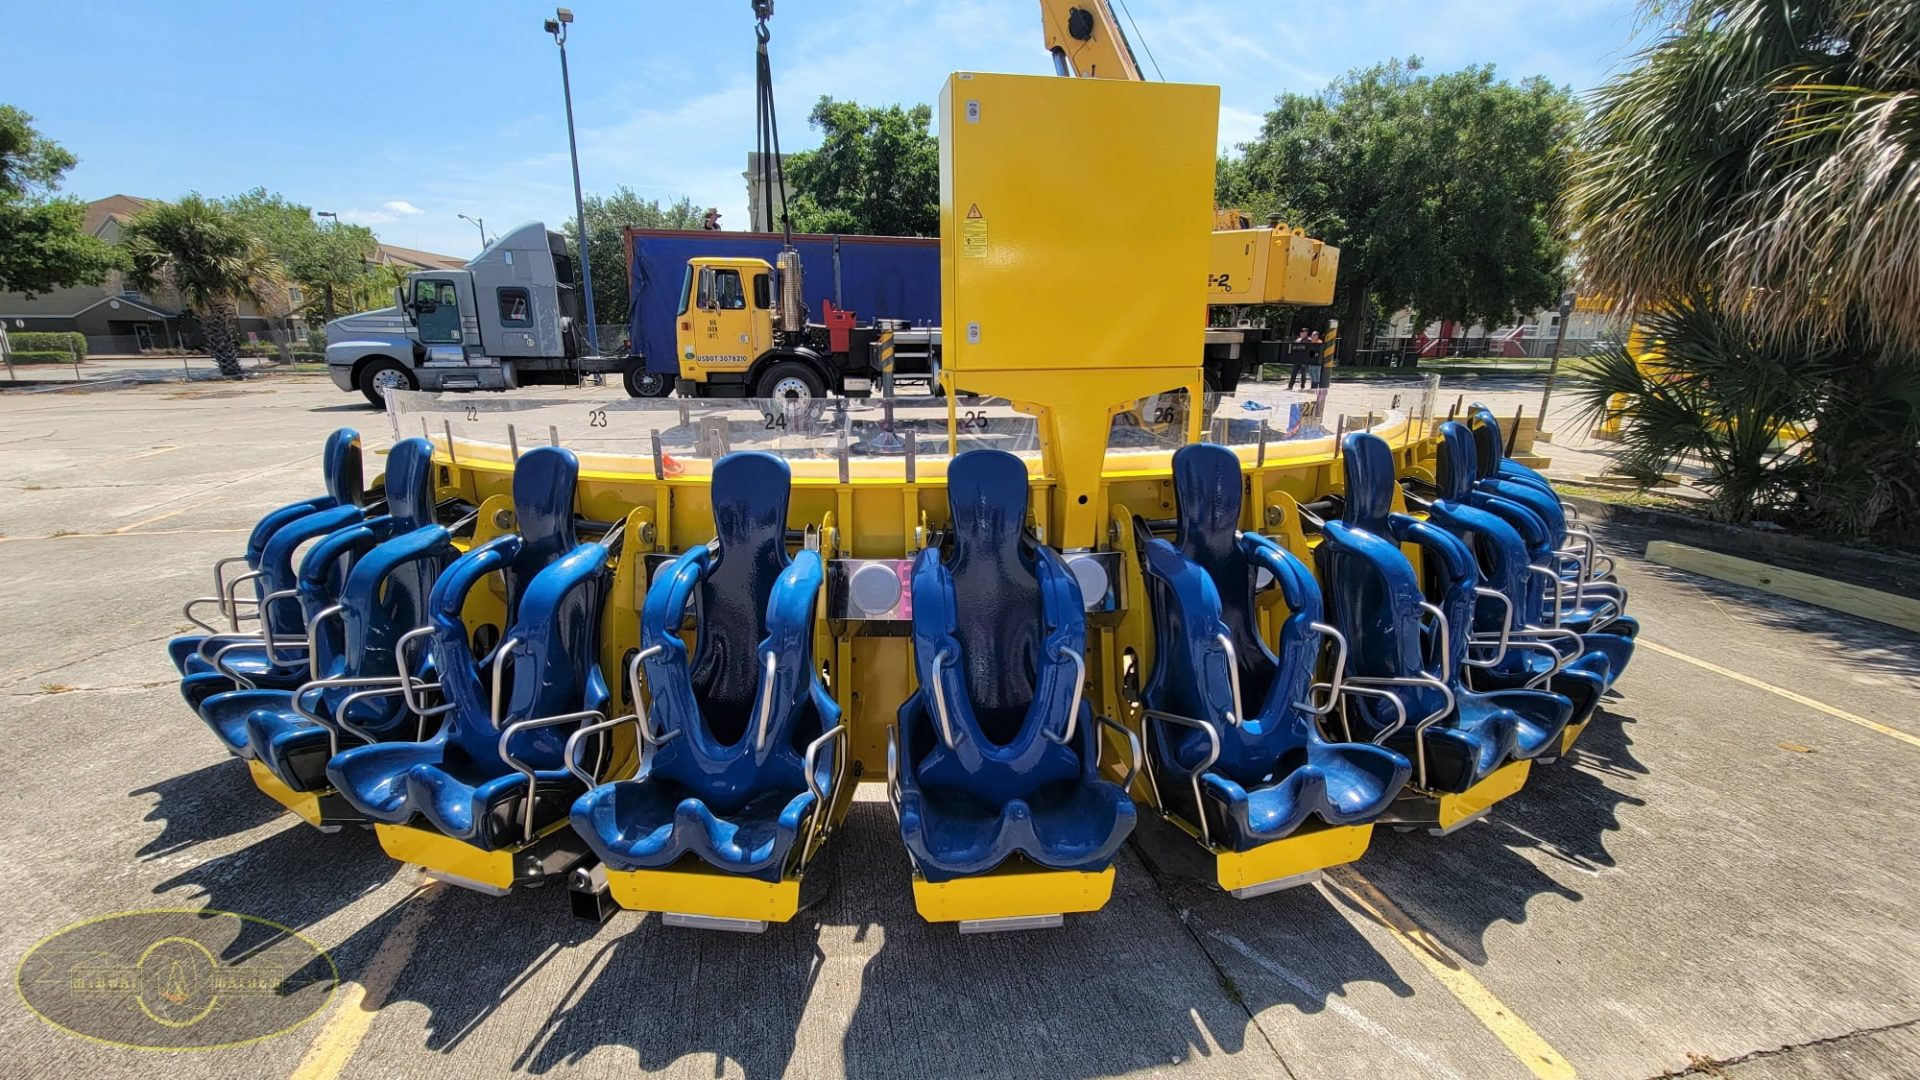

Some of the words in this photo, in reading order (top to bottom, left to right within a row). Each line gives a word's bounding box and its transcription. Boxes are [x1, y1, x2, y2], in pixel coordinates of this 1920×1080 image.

[465, 406, 478, 421] 22
[1154, 407, 1174, 424] 26
[1303, 401, 1317, 416] 27
[588, 410, 608, 428] 23
[764, 412, 787, 430] 24
[964, 410, 988, 428] 25
